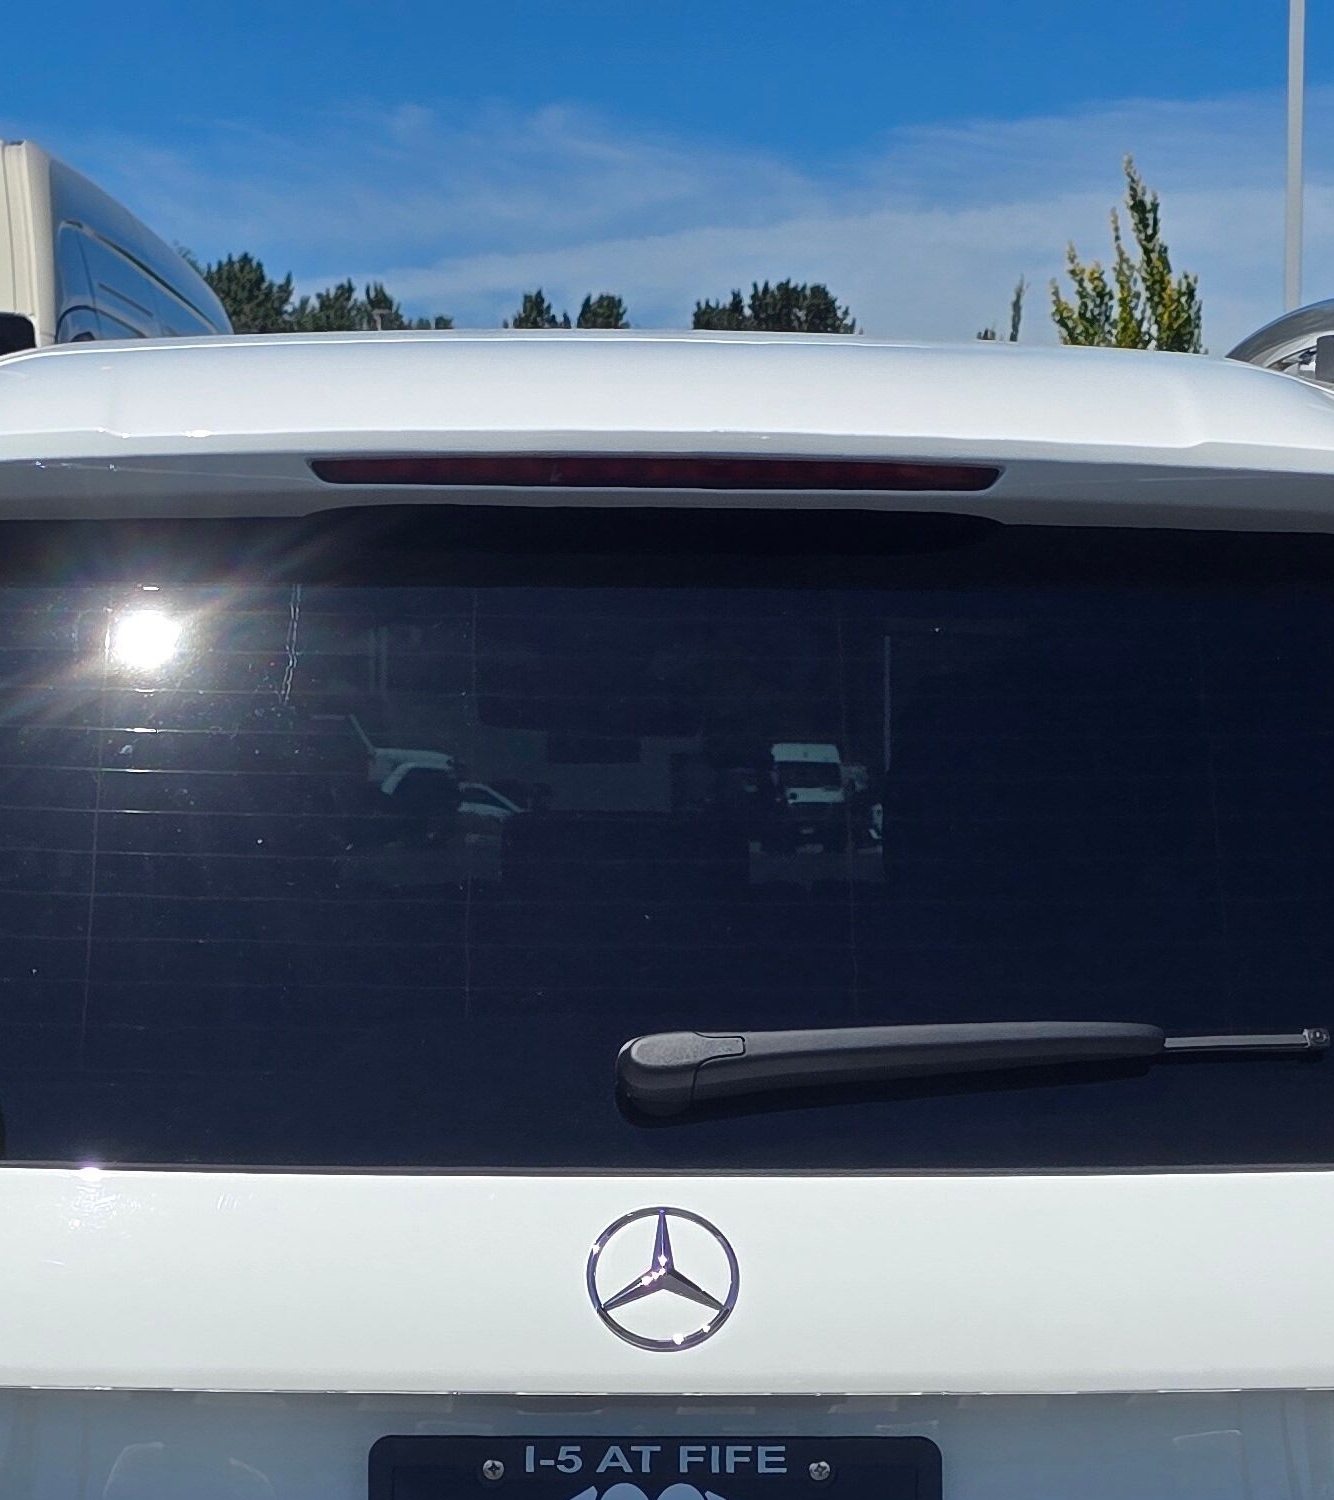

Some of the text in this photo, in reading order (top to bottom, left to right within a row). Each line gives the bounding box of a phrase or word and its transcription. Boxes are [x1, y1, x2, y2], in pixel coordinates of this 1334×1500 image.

[525, 1445, 788, 1474] I-5 AT FIFE
